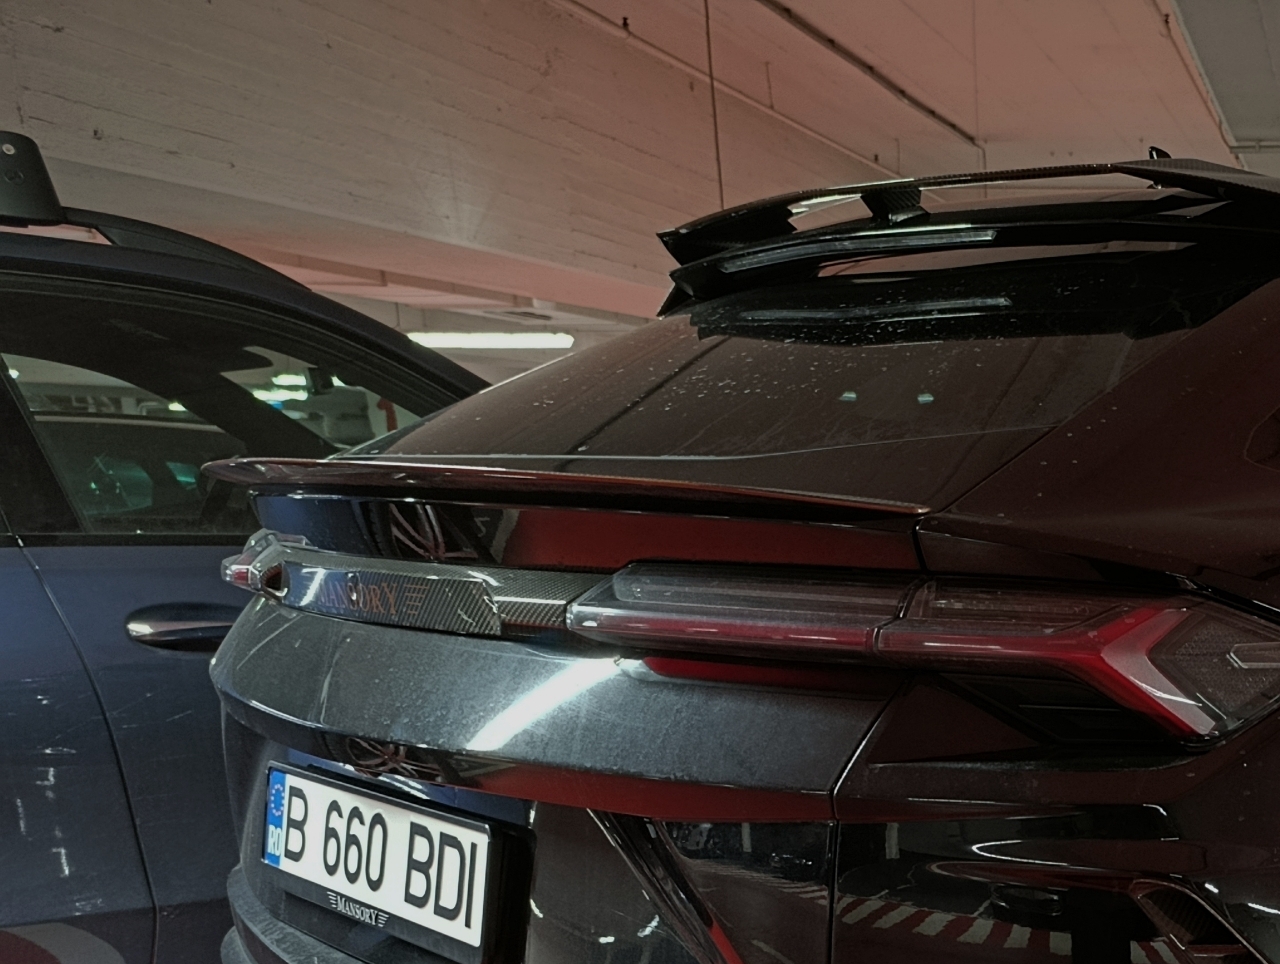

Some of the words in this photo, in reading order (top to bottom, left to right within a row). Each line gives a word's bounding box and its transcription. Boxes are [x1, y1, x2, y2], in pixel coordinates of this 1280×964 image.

[267, 824, 283, 857] RO
[284, 785, 309, 862] B
[323, 799, 389, 892] 660
[404, 821, 478, 929] BDI
[337, 895, 378, 925] MANSORY
